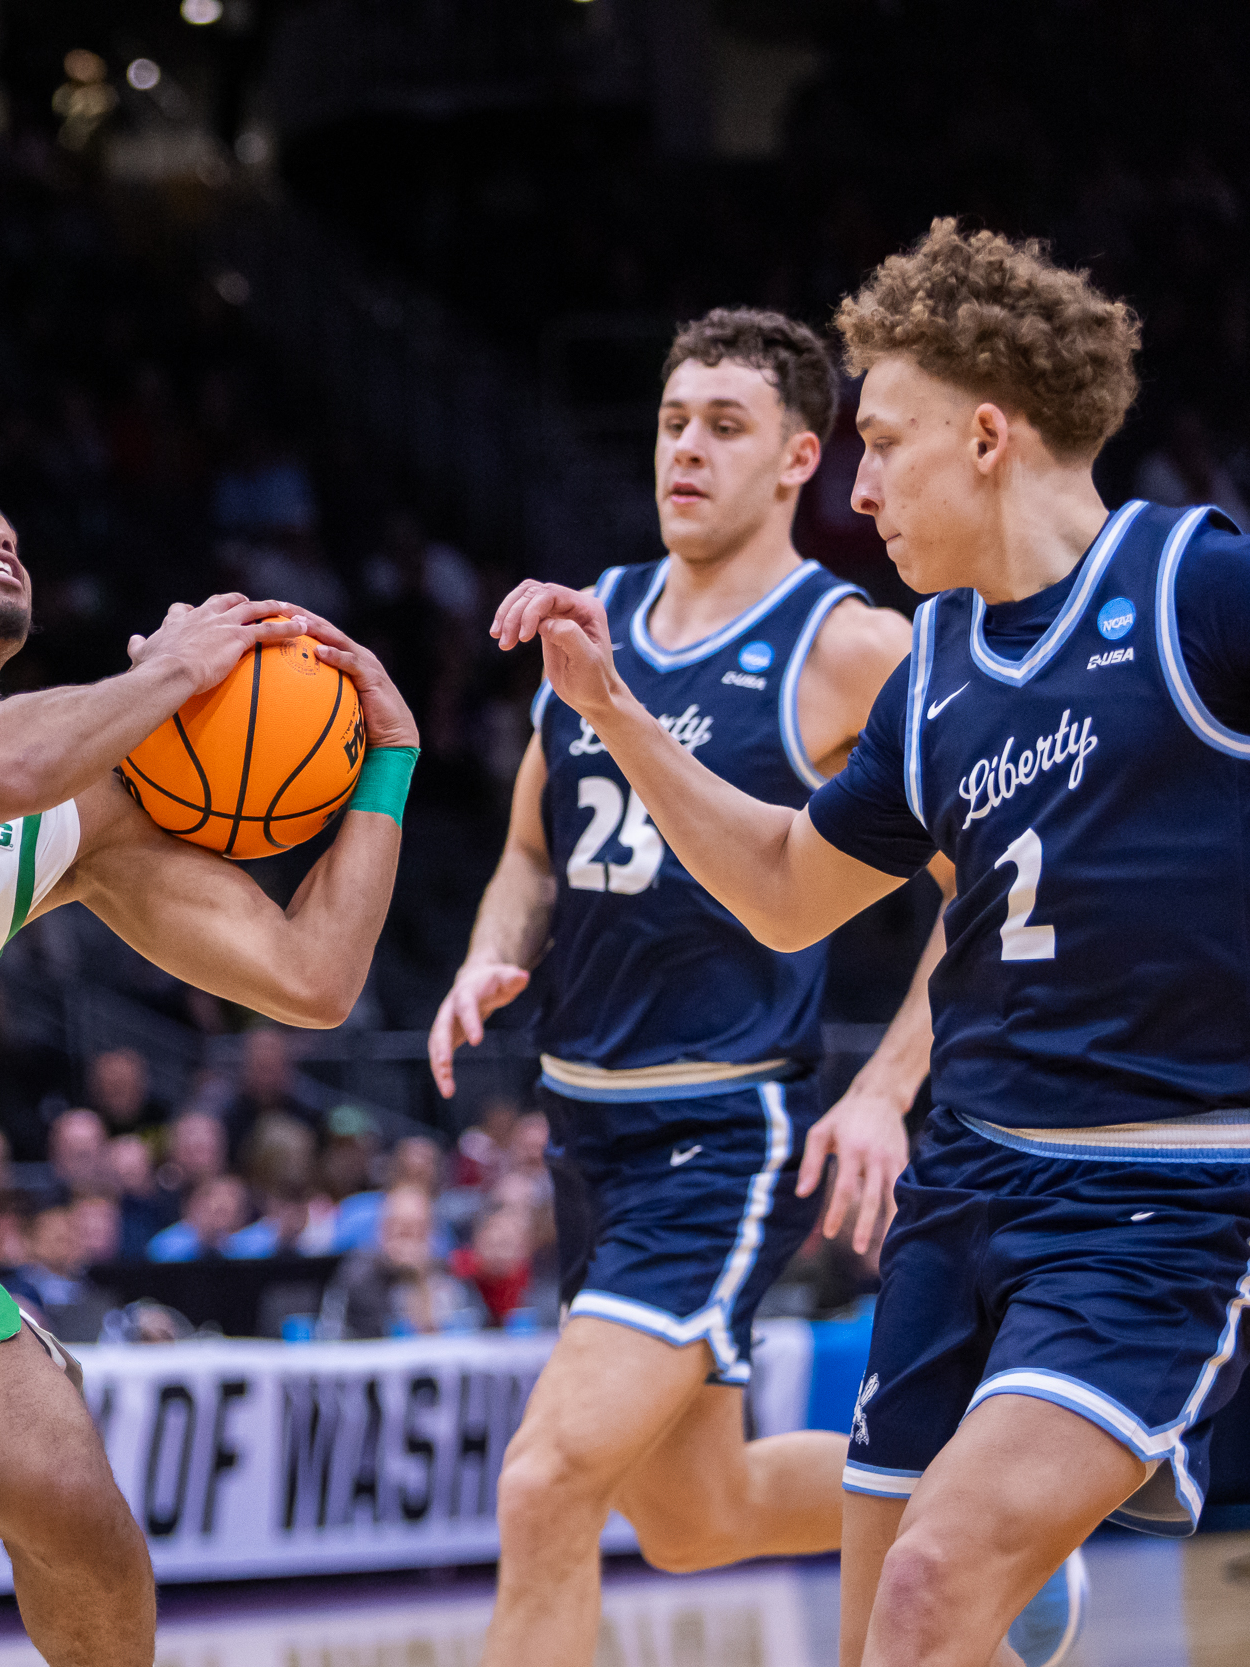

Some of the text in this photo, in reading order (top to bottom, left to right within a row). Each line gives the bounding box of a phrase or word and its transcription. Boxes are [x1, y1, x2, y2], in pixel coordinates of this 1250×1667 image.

[1103, 613, 1133, 632] NCAA
[959, 709, 1098, 830] Liberty
[566, 776, 665, 895] 25
[994, 828, 1056, 961] 2
[145, 1382, 248, 1537] OF
